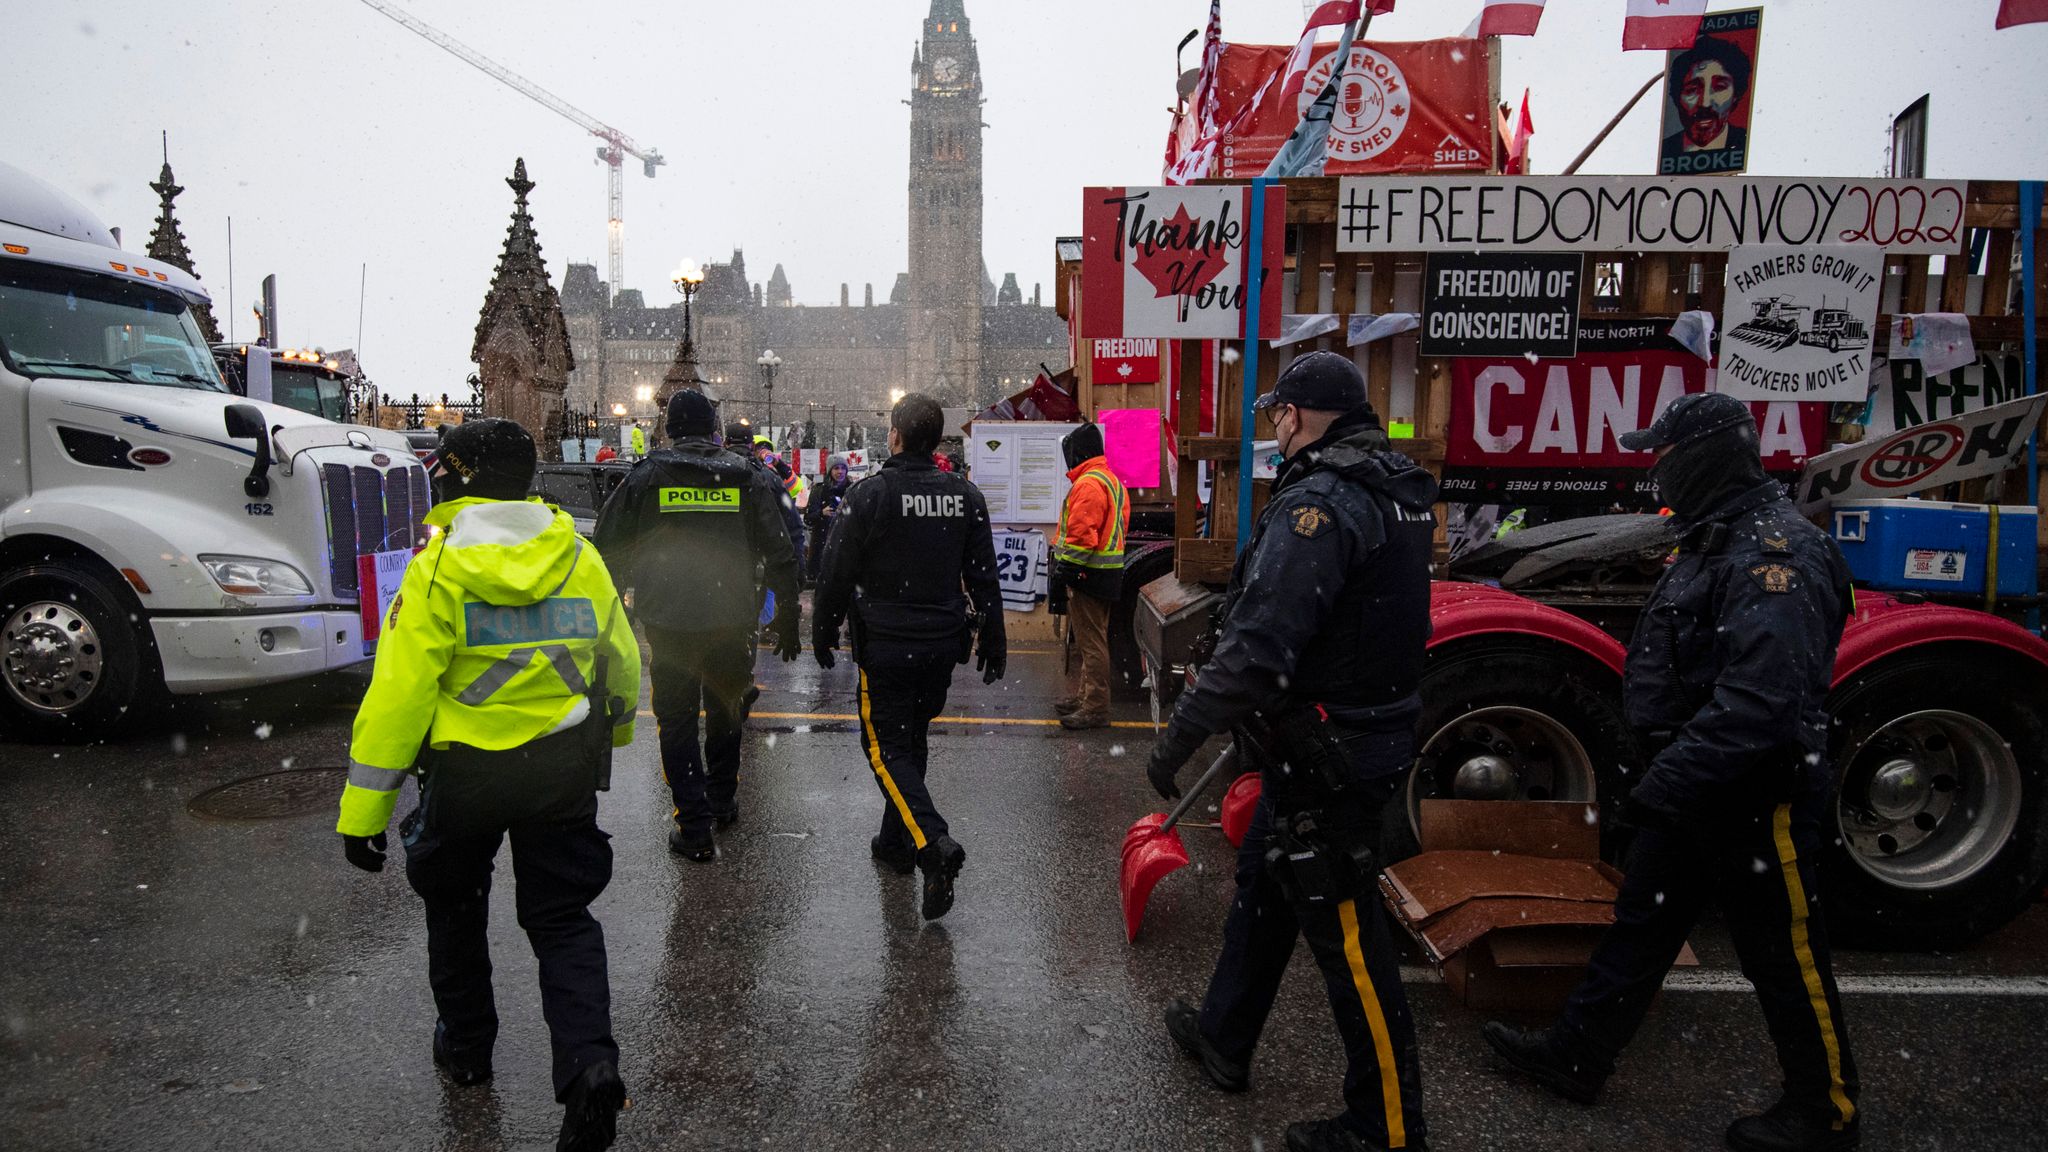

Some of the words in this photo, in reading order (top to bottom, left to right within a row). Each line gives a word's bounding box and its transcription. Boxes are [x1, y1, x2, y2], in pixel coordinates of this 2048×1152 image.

[1744, 13, 1758, 25] IS
[1305, 57, 1337, 97] LIV
[1351, 53, 1400, 94] FROM
[1351, 126, 1392, 154] SHED
[1434, 149, 1480, 162] SHED
[1661, 150, 1743, 174] BROKE
[1104, 191, 1250, 262] Thank
[1438, 269, 1541, 298] FREEDOM
[1545, 270, 1575, 298] OF
[1734, 253, 1806, 294] FARMERS
[1812, 254, 1860, 285] GROW
[1854, 272, 1876, 294] IT
[1429, 311, 1571, 340] CONSCIENCE!
[1578, 328, 1605, 339] RUE
[1609, 325, 1655, 339] NORTH
[1094, 338, 1158, 359] FREEDOM
[1724, 353, 1800, 393] TRUCKERS
[1806, 363, 1848, 391] MOVE
[1850, 354, 1864, 376] IT
[1472, 365, 1807, 457] CANAA
[446, 452, 477, 482] POLICE
[1875, 433, 1948, 480] QR
[668, 490, 732, 503] POLICE
[1443, 479, 1477, 490] TRUE
[1505, 480, 1539, 491] FREE
[1554, 480, 1608, 492] STRONG
[245, 502, 274, 516] 152
[901, 494, 965, 518] POLICE
[1004, 537, 1027, 551] GILL
[997, 552, 1029, 583] 23
[470, 602, 593, 641] POLICE
